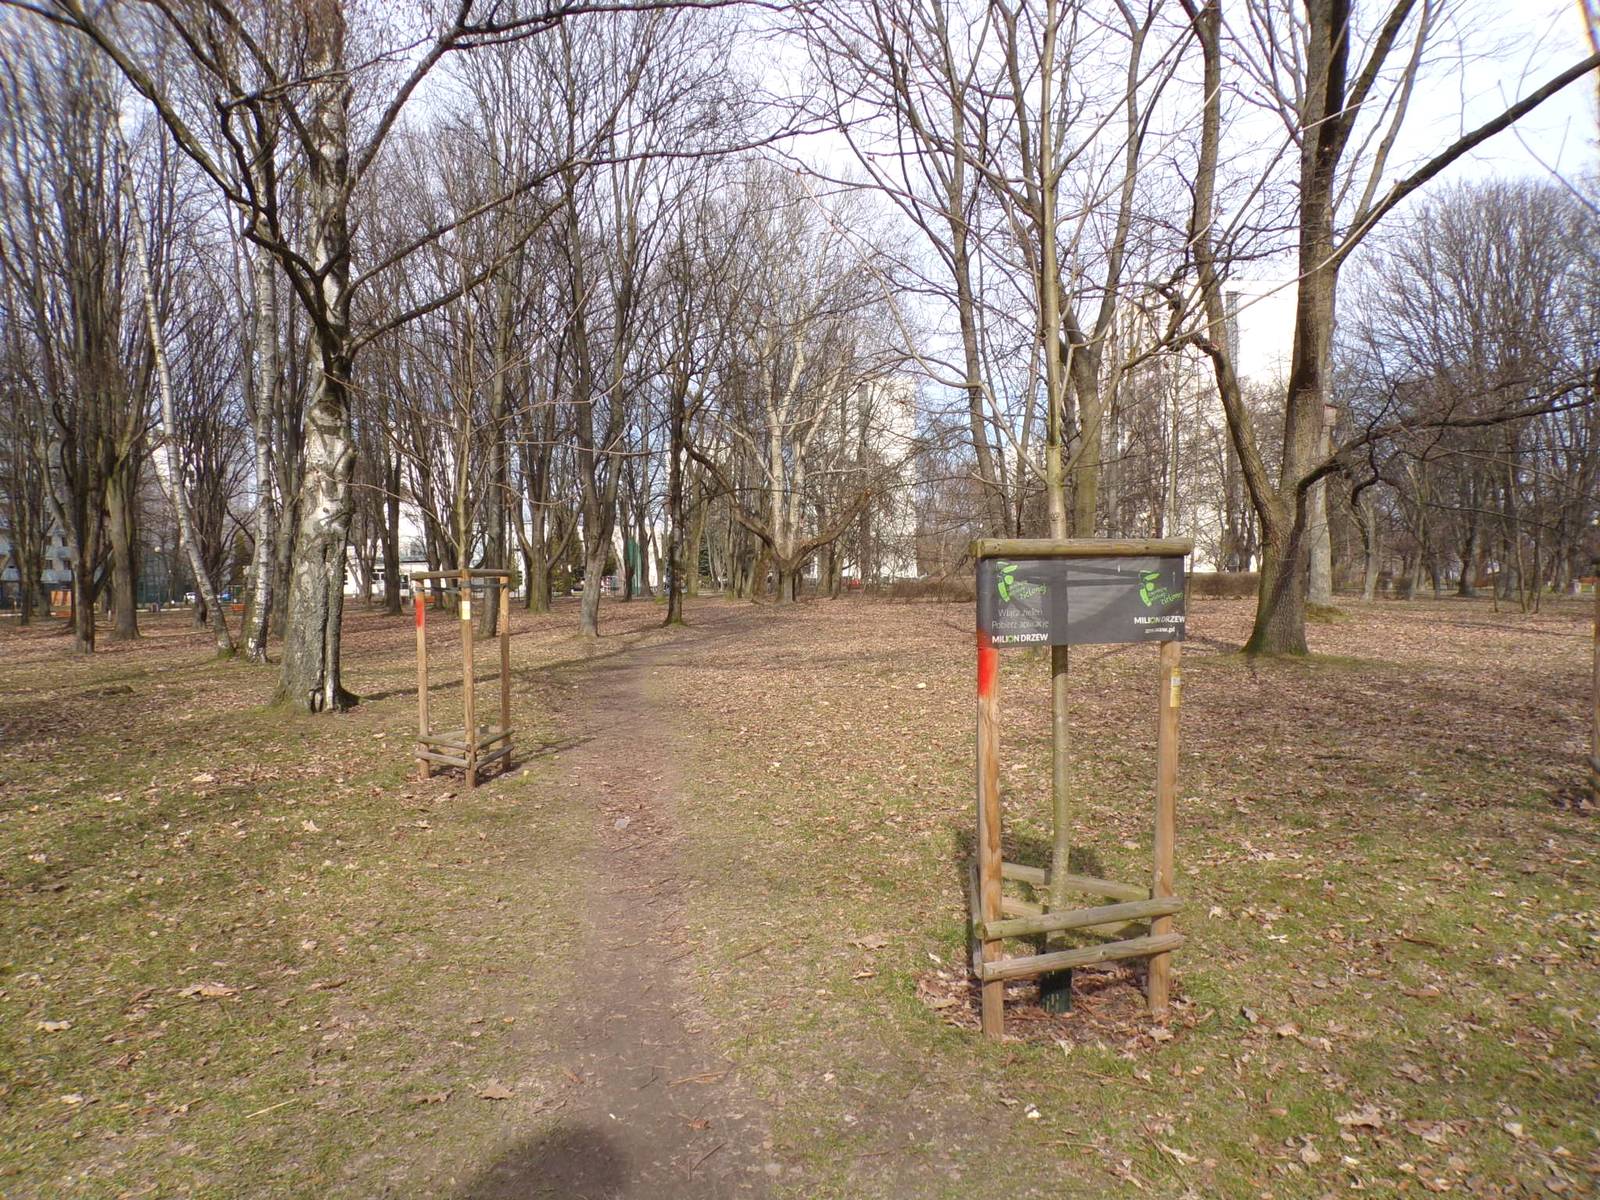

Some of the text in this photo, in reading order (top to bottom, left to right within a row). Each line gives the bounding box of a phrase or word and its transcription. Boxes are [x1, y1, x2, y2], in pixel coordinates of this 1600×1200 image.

[1133, 615, 1185, 625] MILION DRZEW
[991, 632, 1049, 644] MILION DRZEW
